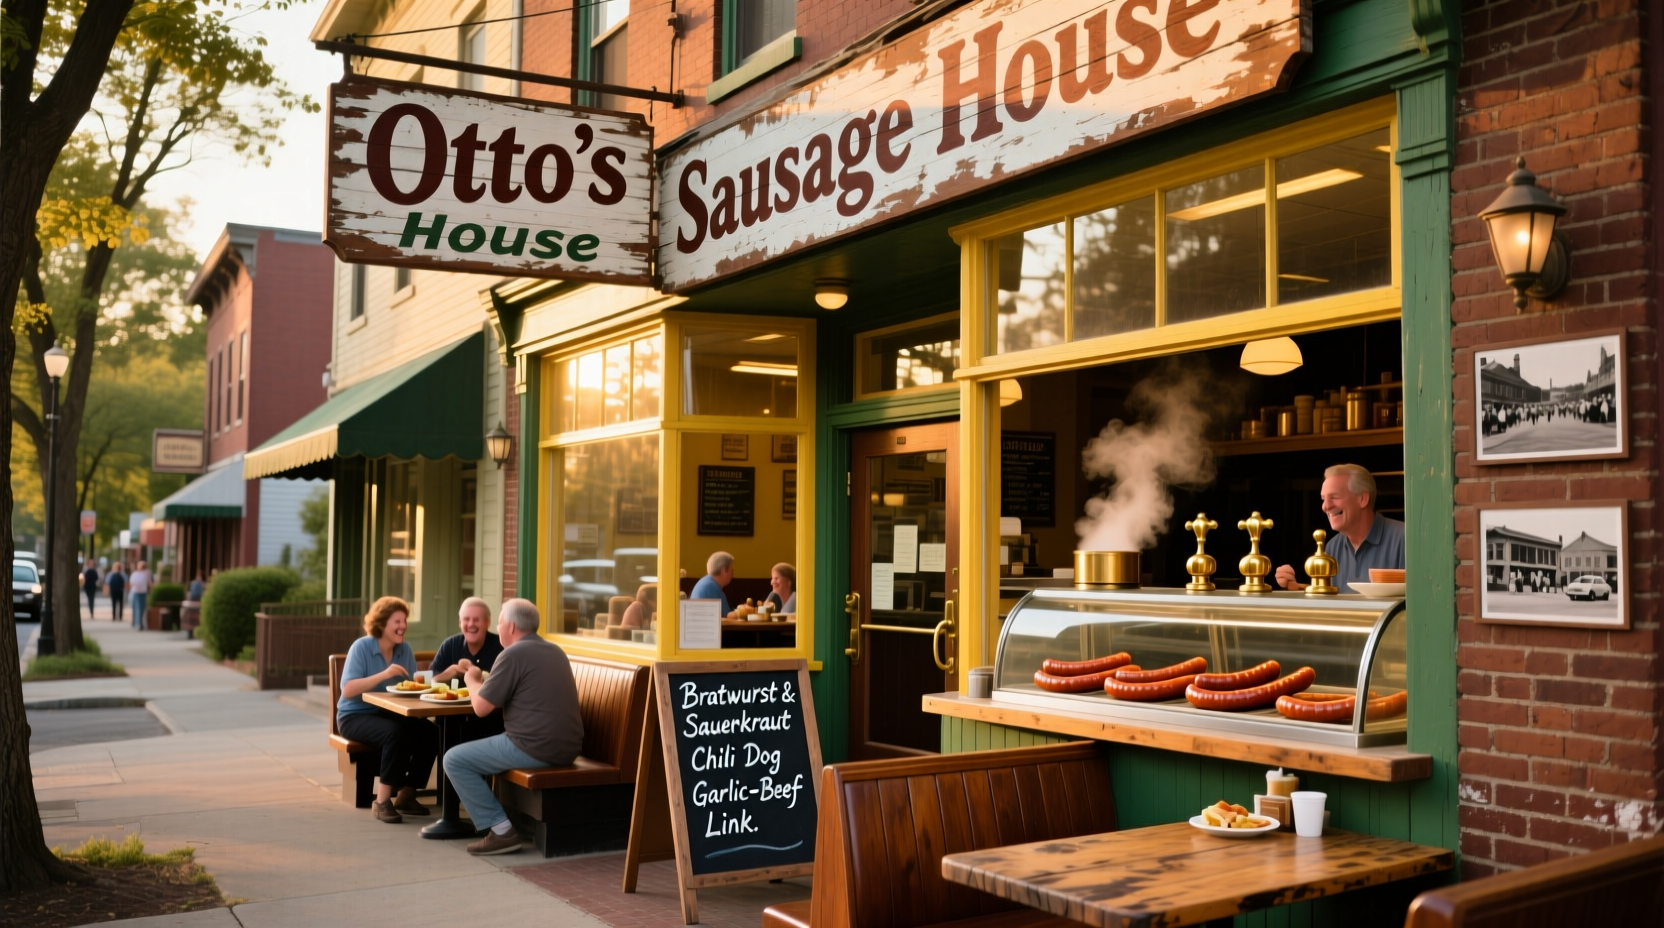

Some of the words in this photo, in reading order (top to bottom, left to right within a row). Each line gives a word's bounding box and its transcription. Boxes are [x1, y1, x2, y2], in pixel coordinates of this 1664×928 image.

[677, 99, 913, 254] Sausage
[937, 0, 1221, 155] House
[367, 103, 627, 205] Otto's
[399, 212, 600, 262] House
[679, 681, 778, 709] Bratwurst
[782, 681, 796, 703] &
[683, 710, 791, 738] Sauerkraut
[691, 744, 736, 771] Chili
[743, 742, 781, 775] Dog
[693, 774, 803, 808] Garlic-Beef
[705, 809, 759, 838] Link.
